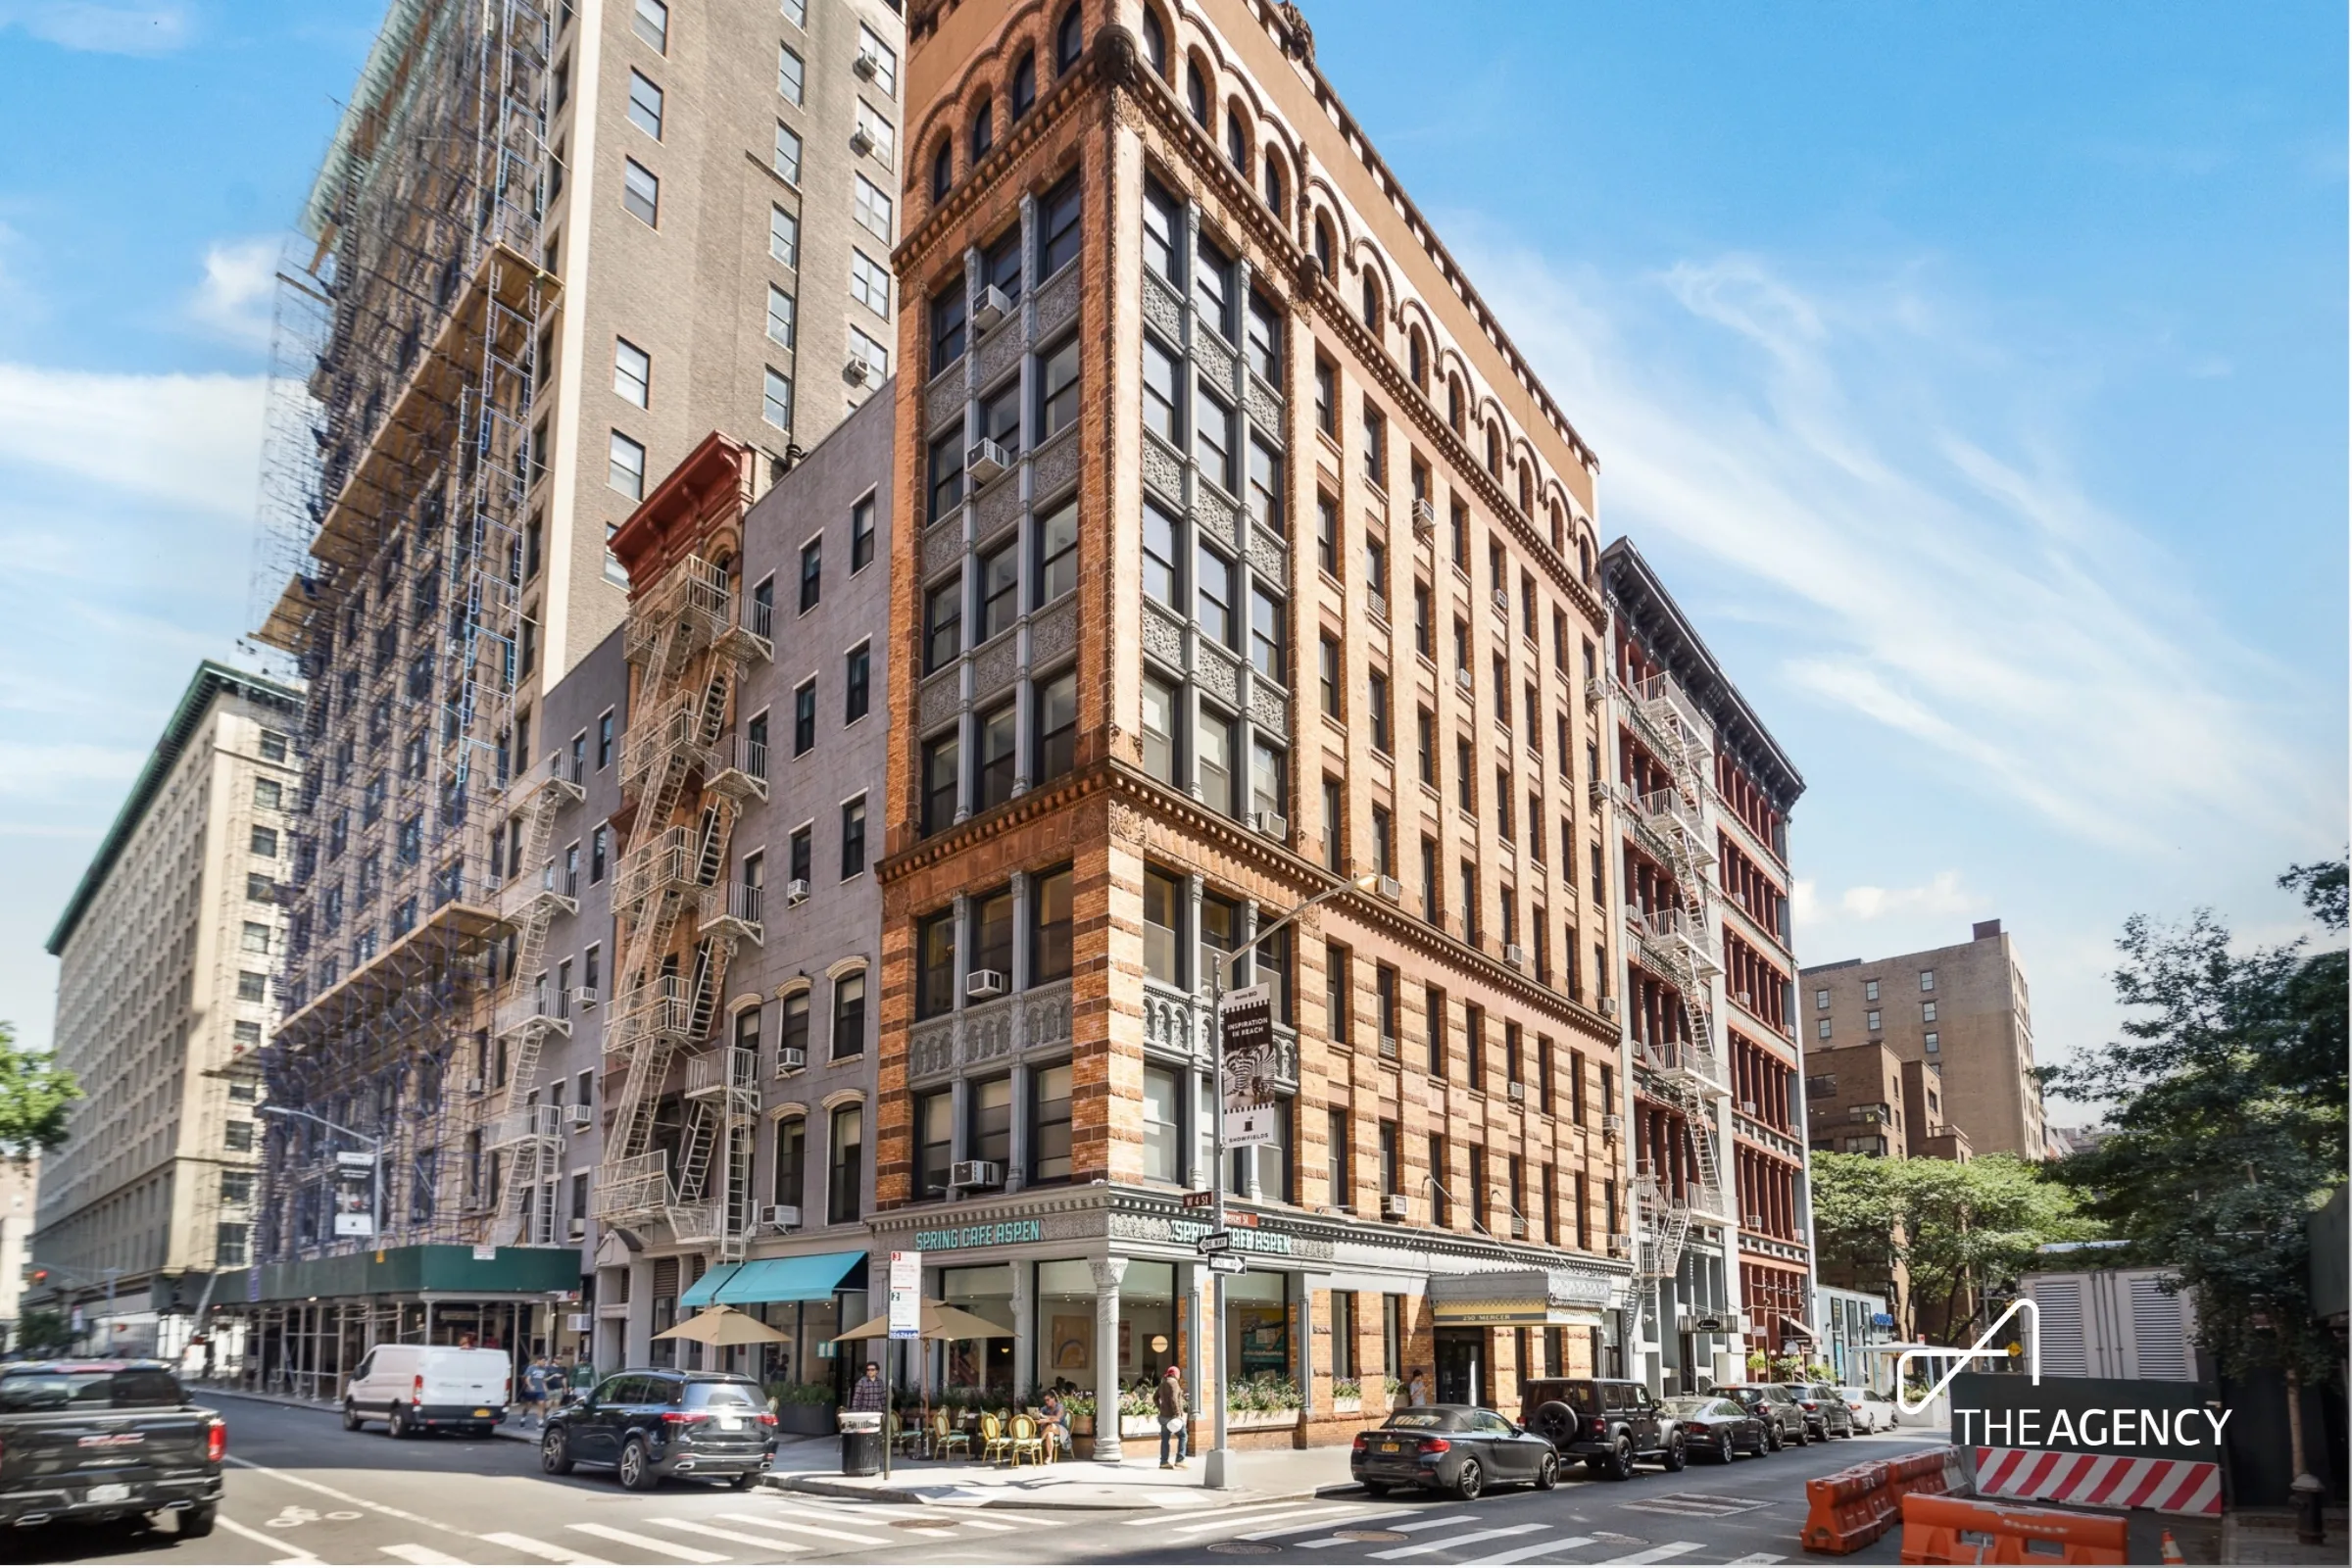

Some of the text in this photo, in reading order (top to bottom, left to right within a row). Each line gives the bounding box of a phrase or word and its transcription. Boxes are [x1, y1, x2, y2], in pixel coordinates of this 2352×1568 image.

[1228, 1017, 1268, 1031] INSPIRATION
[1241, 1026, 1263, 1036] REACH
[1229, 1132, 1268, 1143] SHOWFIELDS
[1187, 1197, 1193, 1206] W
[915, 1219, 1039, 1250] SPRING CAFE ASPEN
[1202, 1237, 1226, 1249] ONE WAY
[1255, 1232, 1292, 1254] ASPEN
